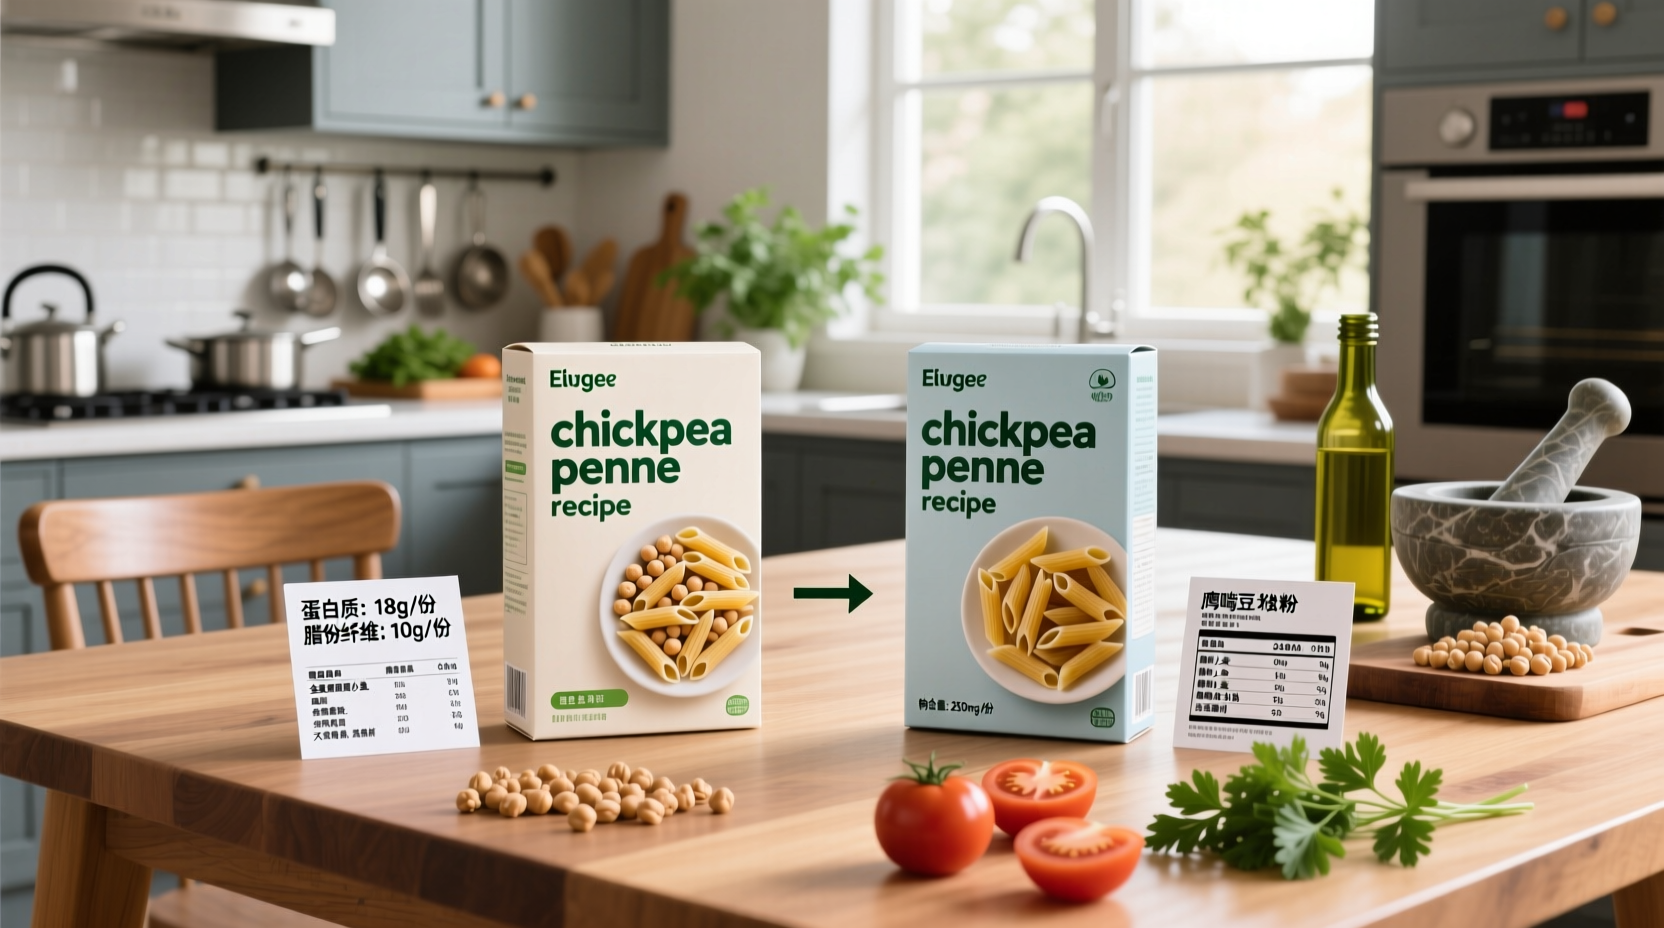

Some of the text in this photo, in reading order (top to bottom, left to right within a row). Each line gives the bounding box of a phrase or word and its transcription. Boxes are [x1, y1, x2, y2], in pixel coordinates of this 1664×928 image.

[550, 409, 732, 454] chickpea
[921, 409, 1096, 456] chickpea
[551, 456, 681, 494] penne
[921, 454, 1045, 490] penne
[551, 493, 632, 522] recipe
[922, 489, 997, 519] recipe
[374, 593, 437, 620] 18g/份
[390, 617, 451, 643] 10g/份
